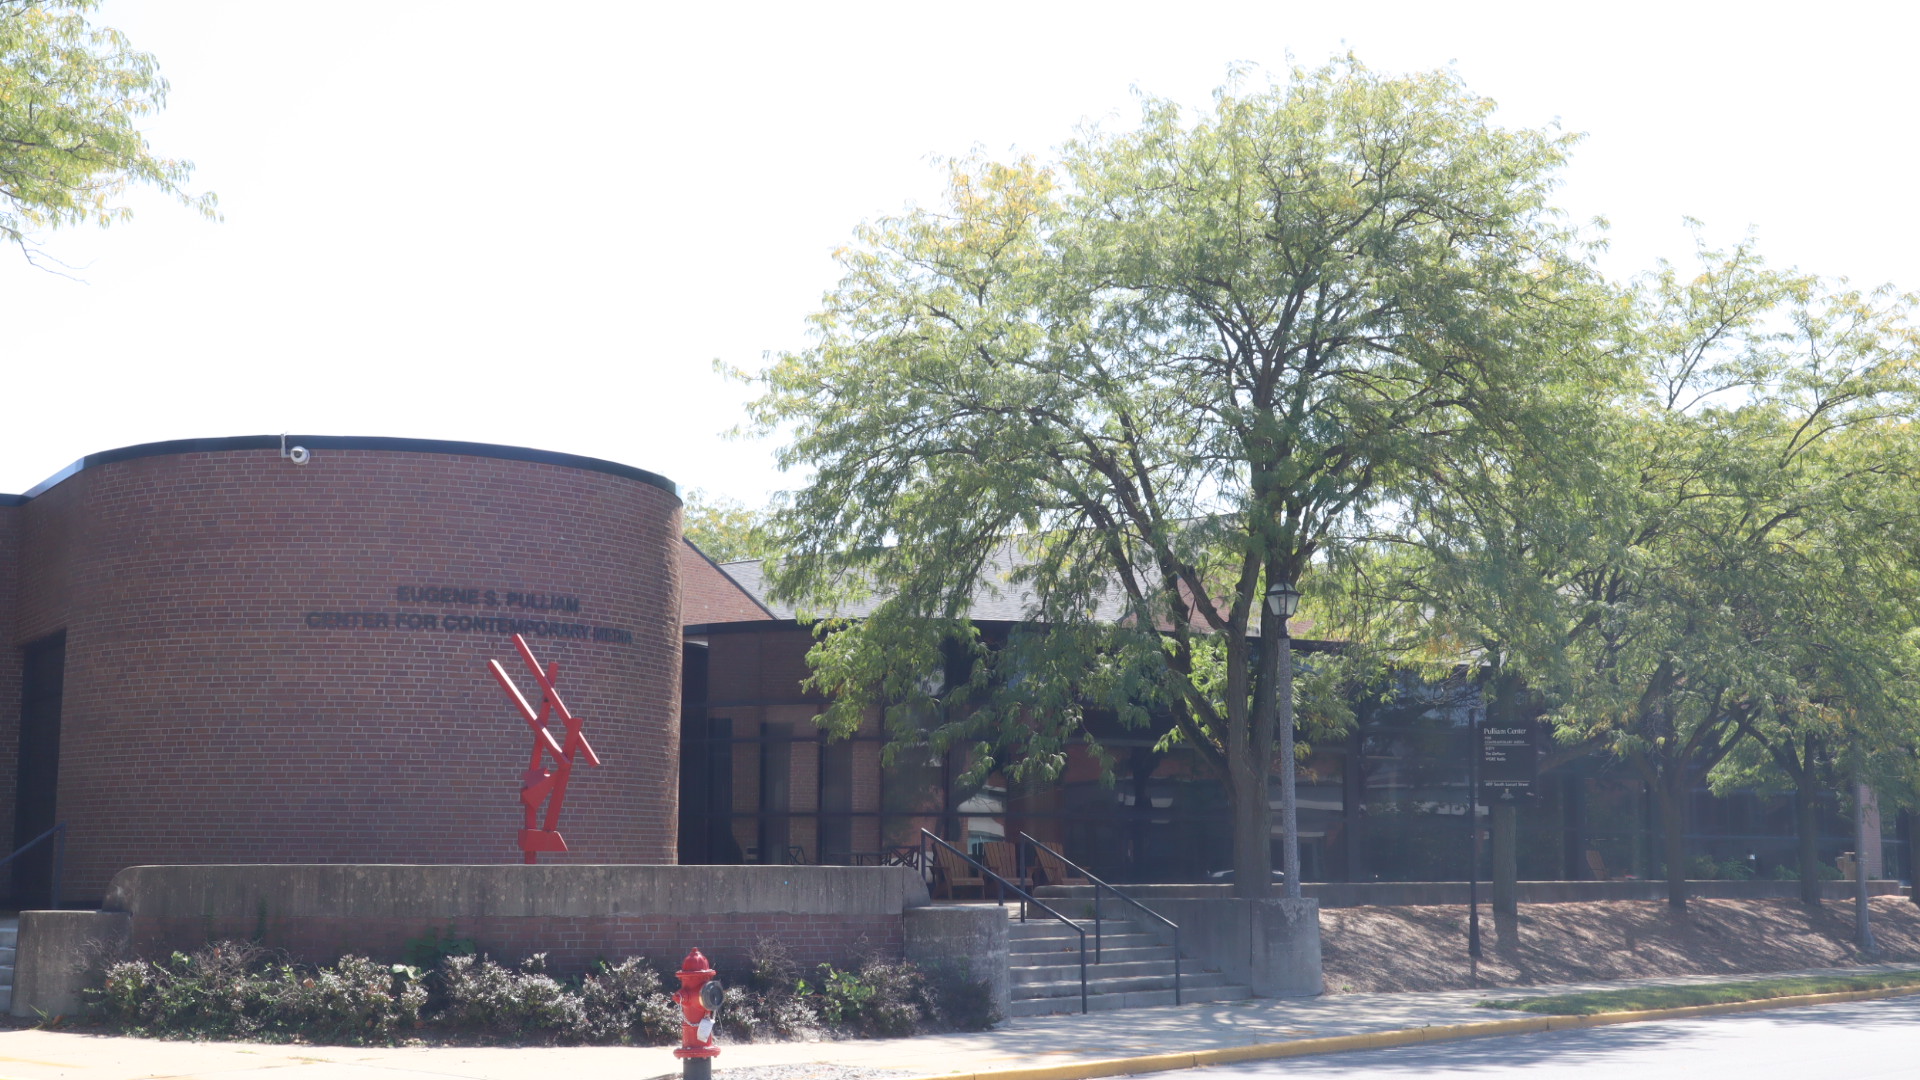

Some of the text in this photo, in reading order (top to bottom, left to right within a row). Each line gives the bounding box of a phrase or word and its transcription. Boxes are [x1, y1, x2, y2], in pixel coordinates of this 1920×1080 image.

[397, 585, 580, 612] EUGENE S. PULLIAM
[306, 611, 633, 645] CENTER FOR CONTEMPORARY MEDIA
[1483, 727, 1527, 735] Pulliam Center
